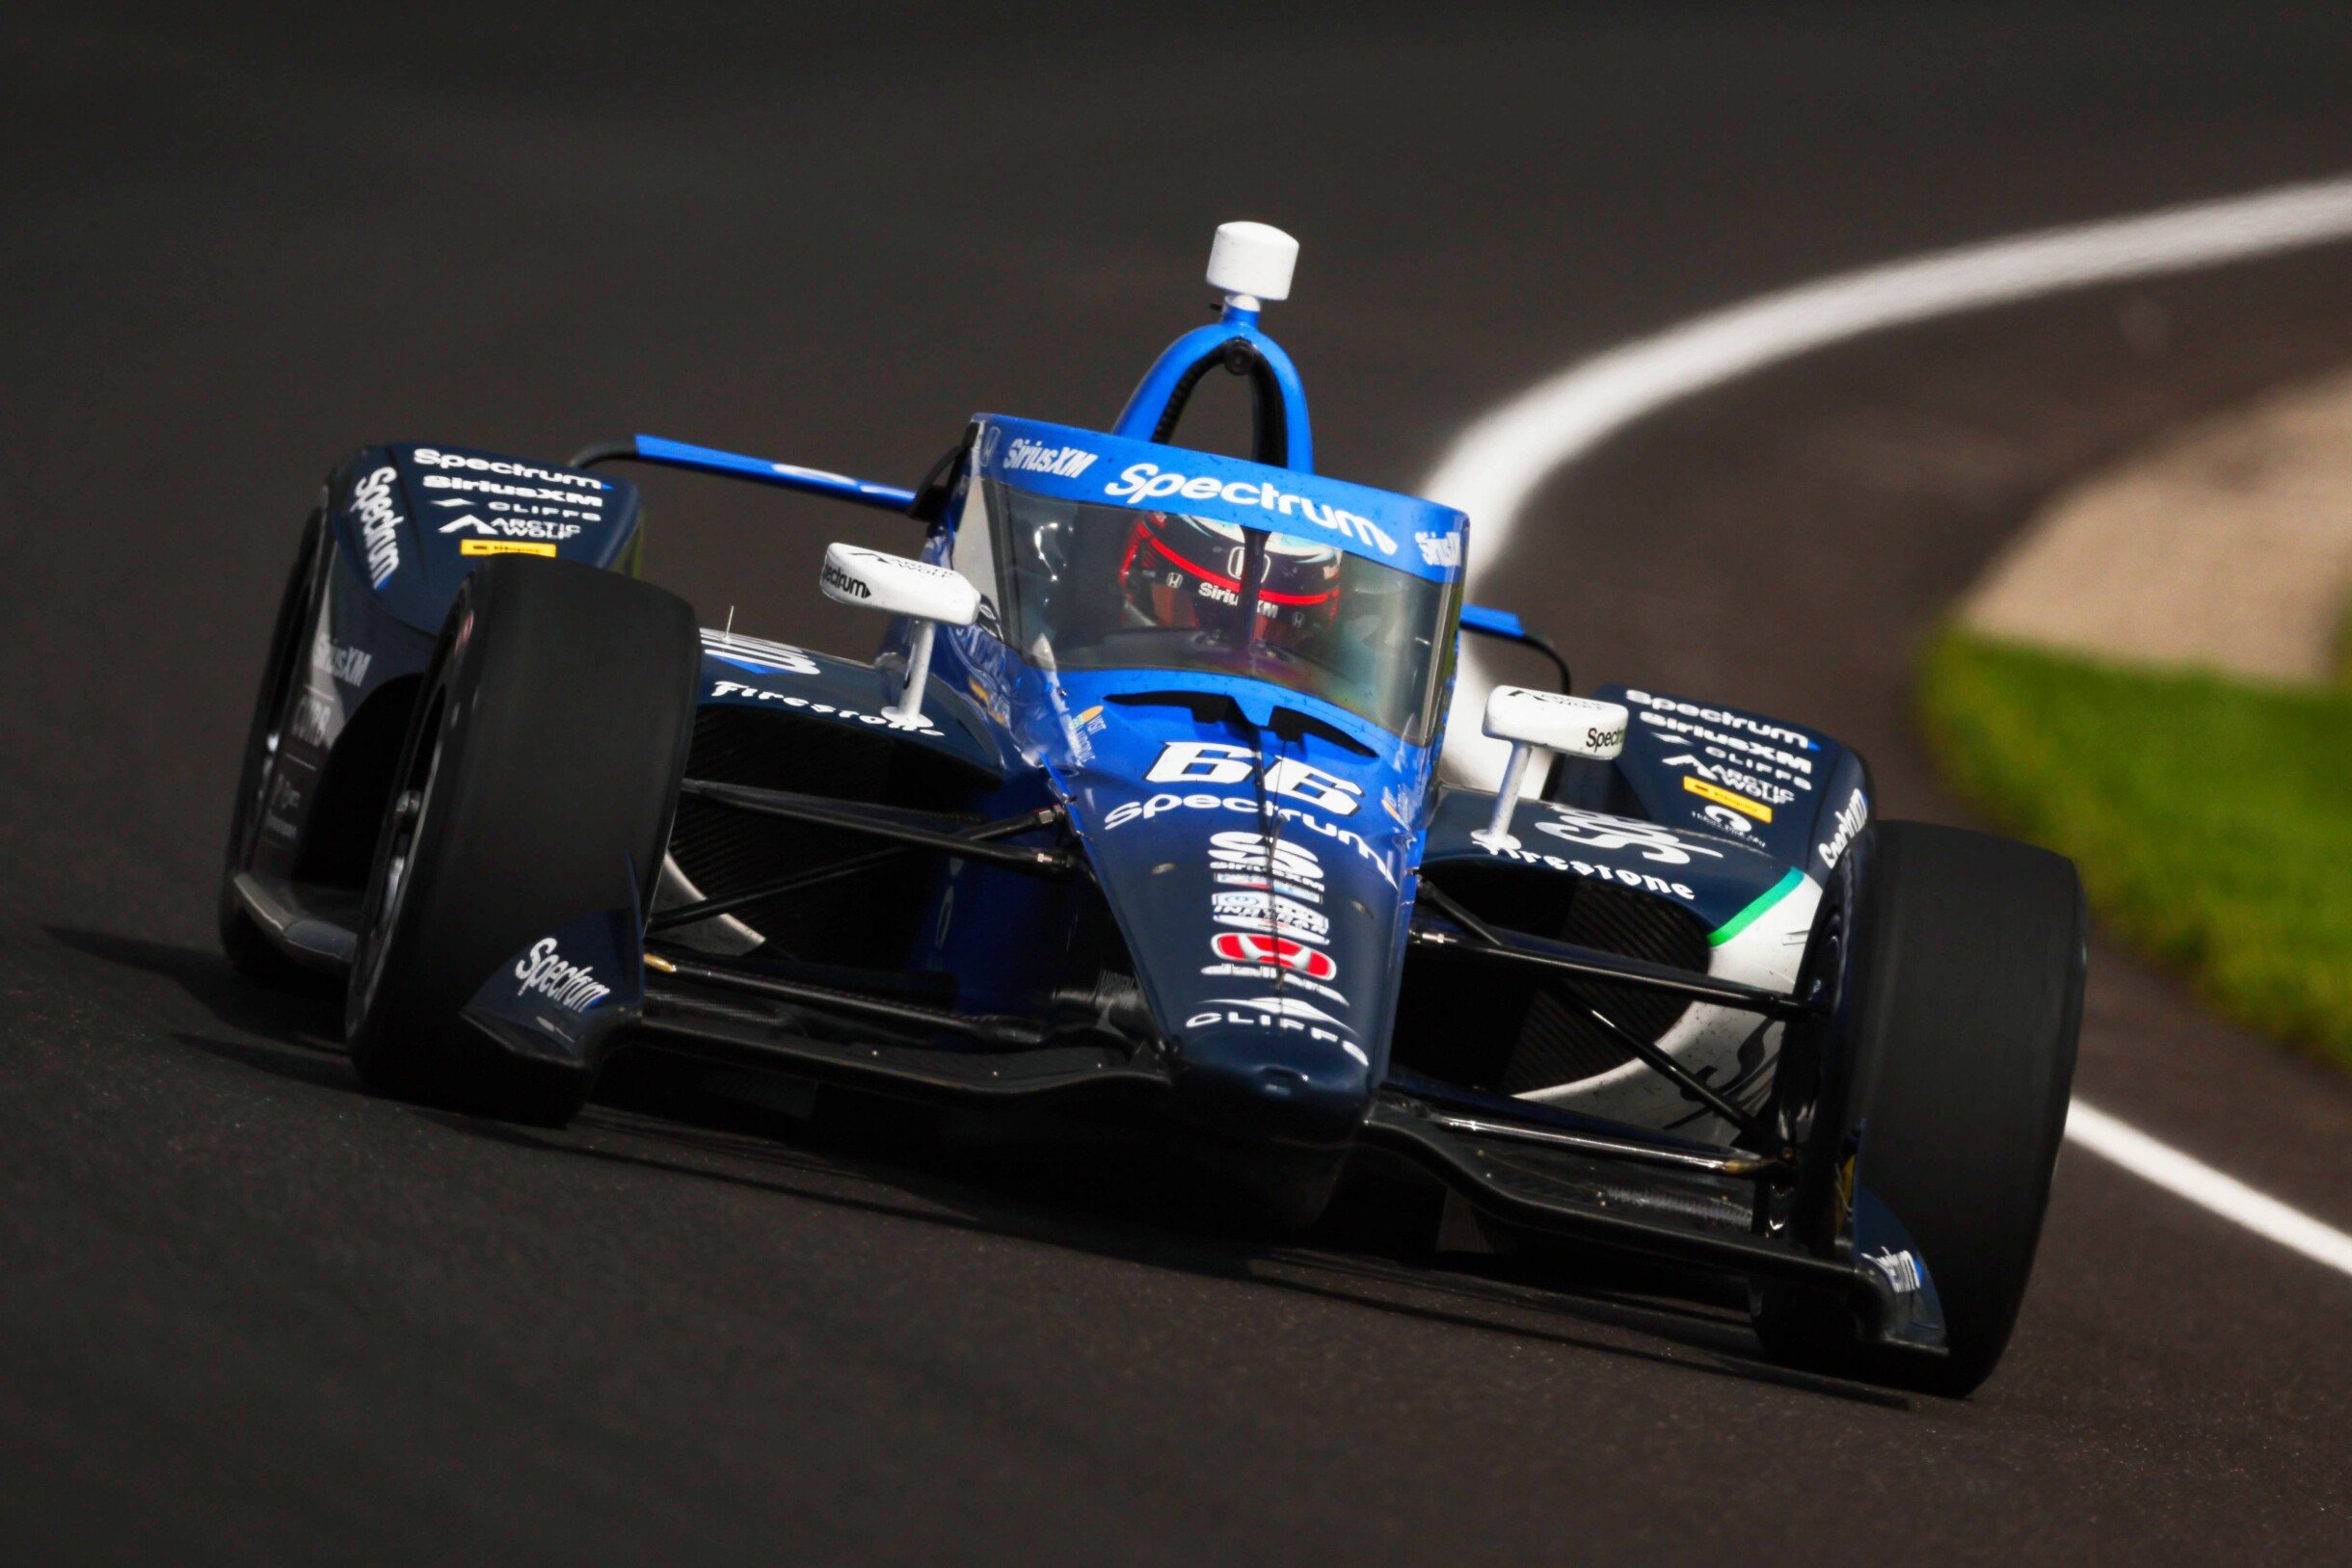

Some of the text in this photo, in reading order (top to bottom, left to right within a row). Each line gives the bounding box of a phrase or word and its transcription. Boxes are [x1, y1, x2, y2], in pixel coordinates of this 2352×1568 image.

[414, 448, 602, 490] Spectrum
[1002, 437, 1098, 479] SiriusXM
[423, 475, 603, 507] SiriusXM
[488, 500, 601, 522] CLIFFS
[1104, 463, 1398, 556] Spectrum
[350, 465, 404, 591] Spectrum
[1197, 582, 1279, 620] SiriuXM
[1626, 689, 1808, 750] Spectrum
[1640, 711, 1812, 774] SiriusXM
[1143, 741, 1364, 816] 66
[1705, 746, 1812, 790] CLIFFS
[1105, 793, 1399, 891] Spectrum
[515, 937, 611, 1013] Spectrum
